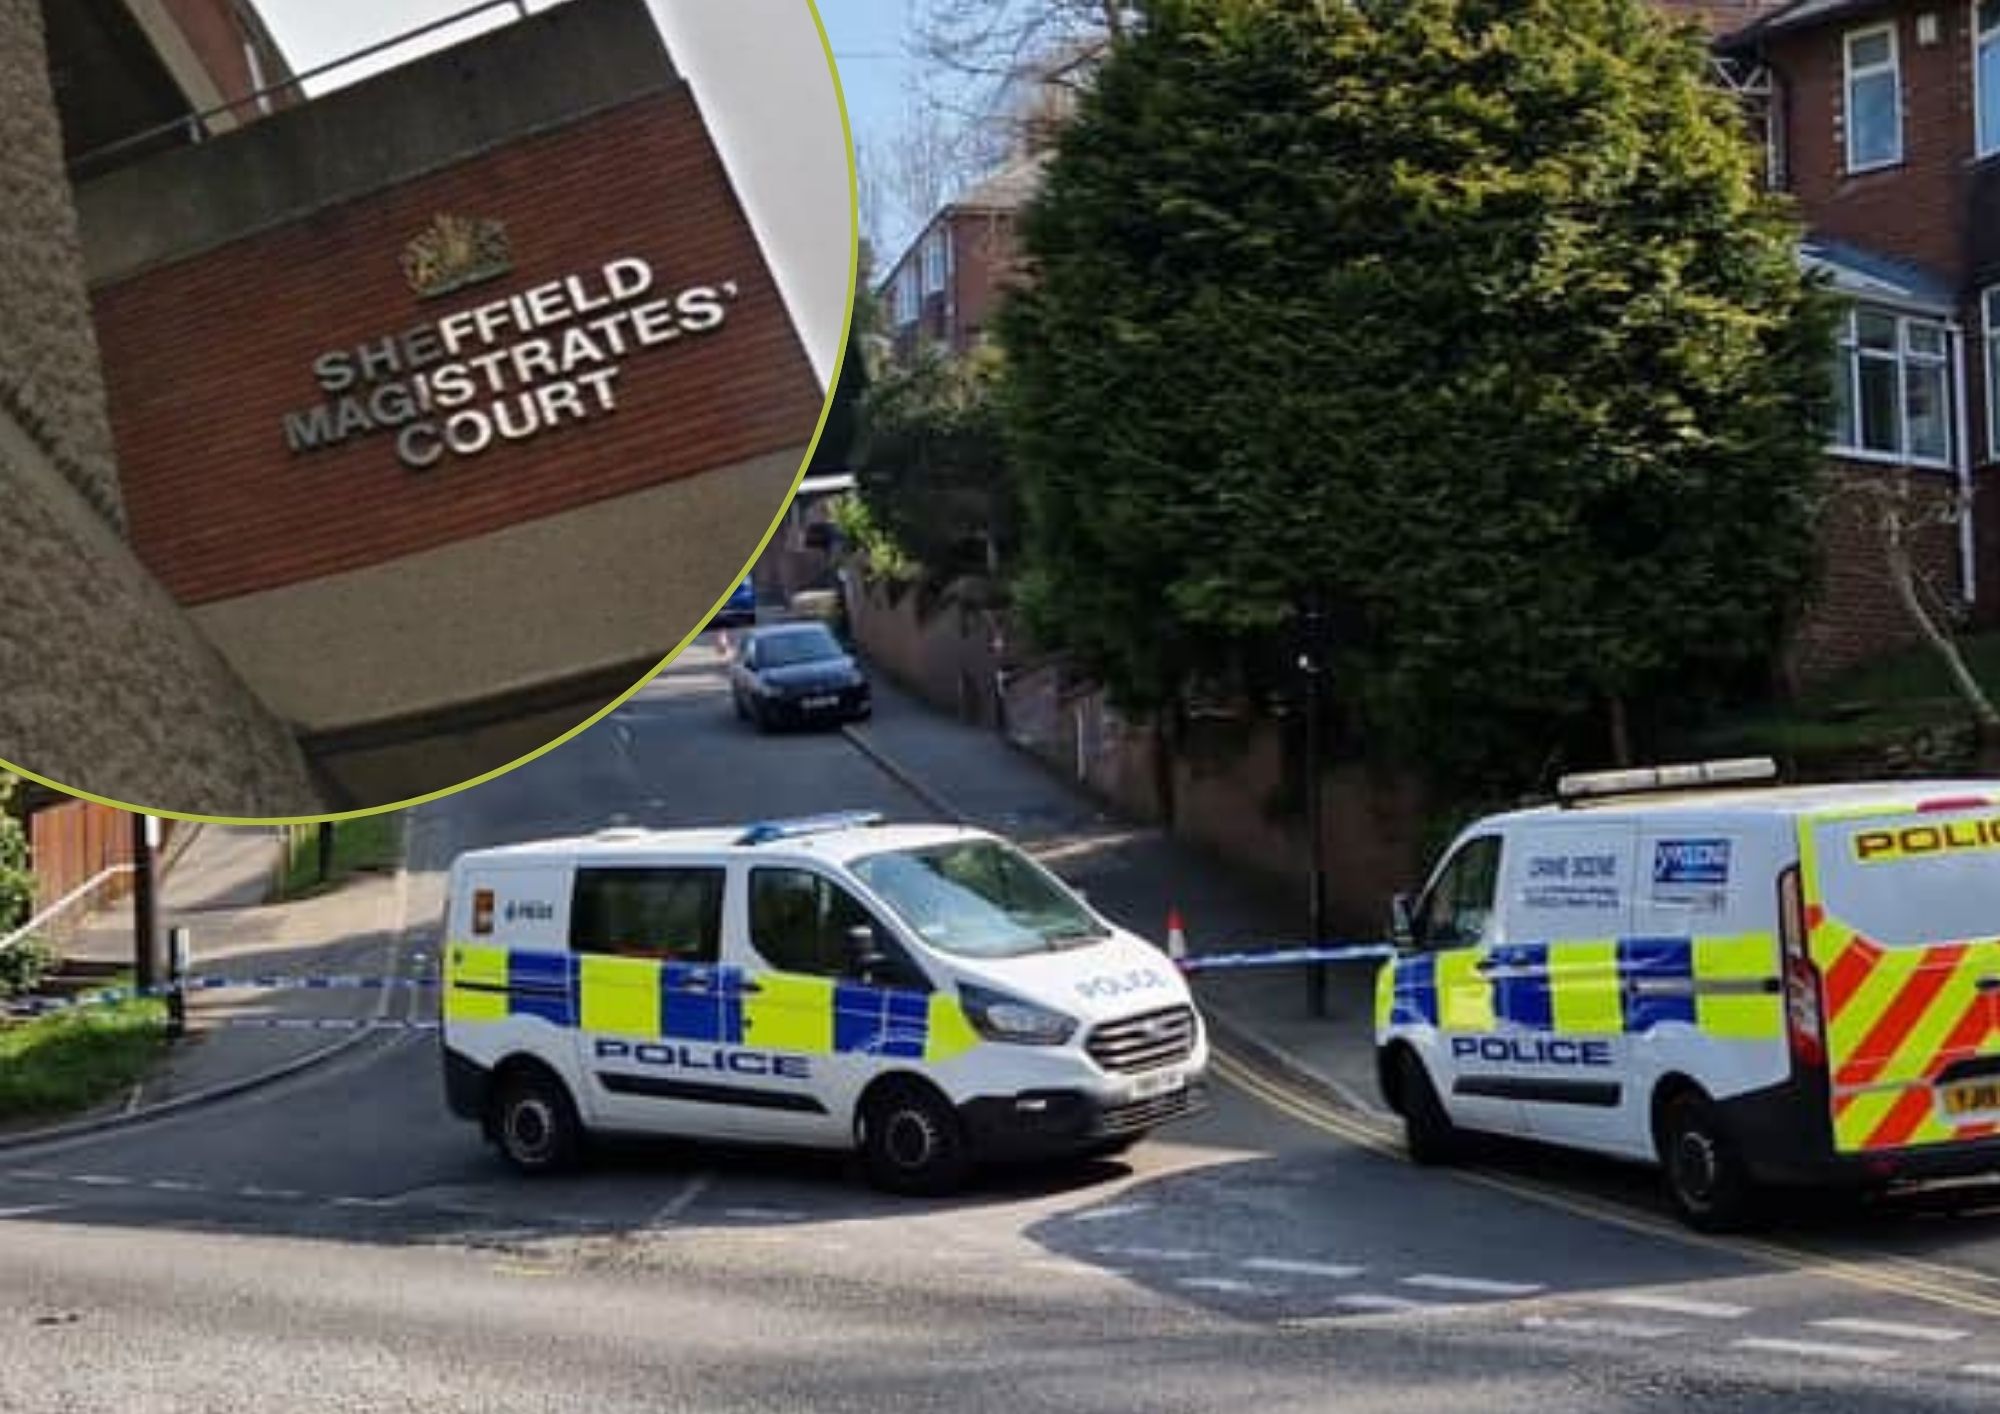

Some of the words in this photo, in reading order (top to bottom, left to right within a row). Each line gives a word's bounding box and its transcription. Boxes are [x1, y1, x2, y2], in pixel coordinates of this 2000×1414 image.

[284, 281, 738, 452] MAGISTRATES'
[314, 257, 654, 392] SHEFFIELD
[397, 367, 620, 467] COURT
[594, 1038, 811, 1079] POLICE
[1452, 1037, 1612, 1066] POLICE
